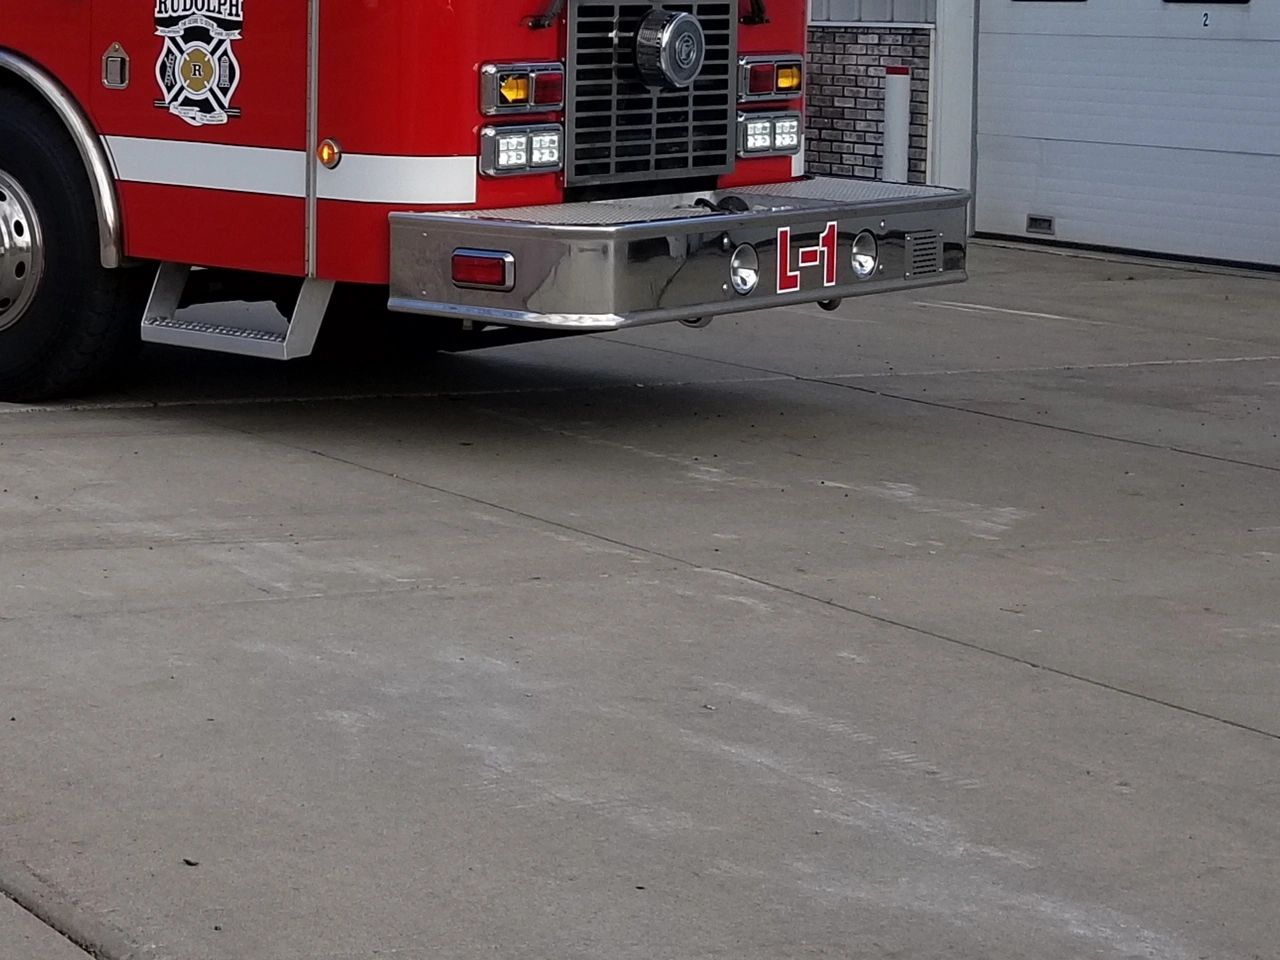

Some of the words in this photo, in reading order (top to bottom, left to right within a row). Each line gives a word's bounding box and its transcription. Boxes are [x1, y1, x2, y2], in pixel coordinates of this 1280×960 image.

[1202, 11, 1209, 27] 2
[191, 63, 203, 77] R
[776, 220, 838, 295] L-1
